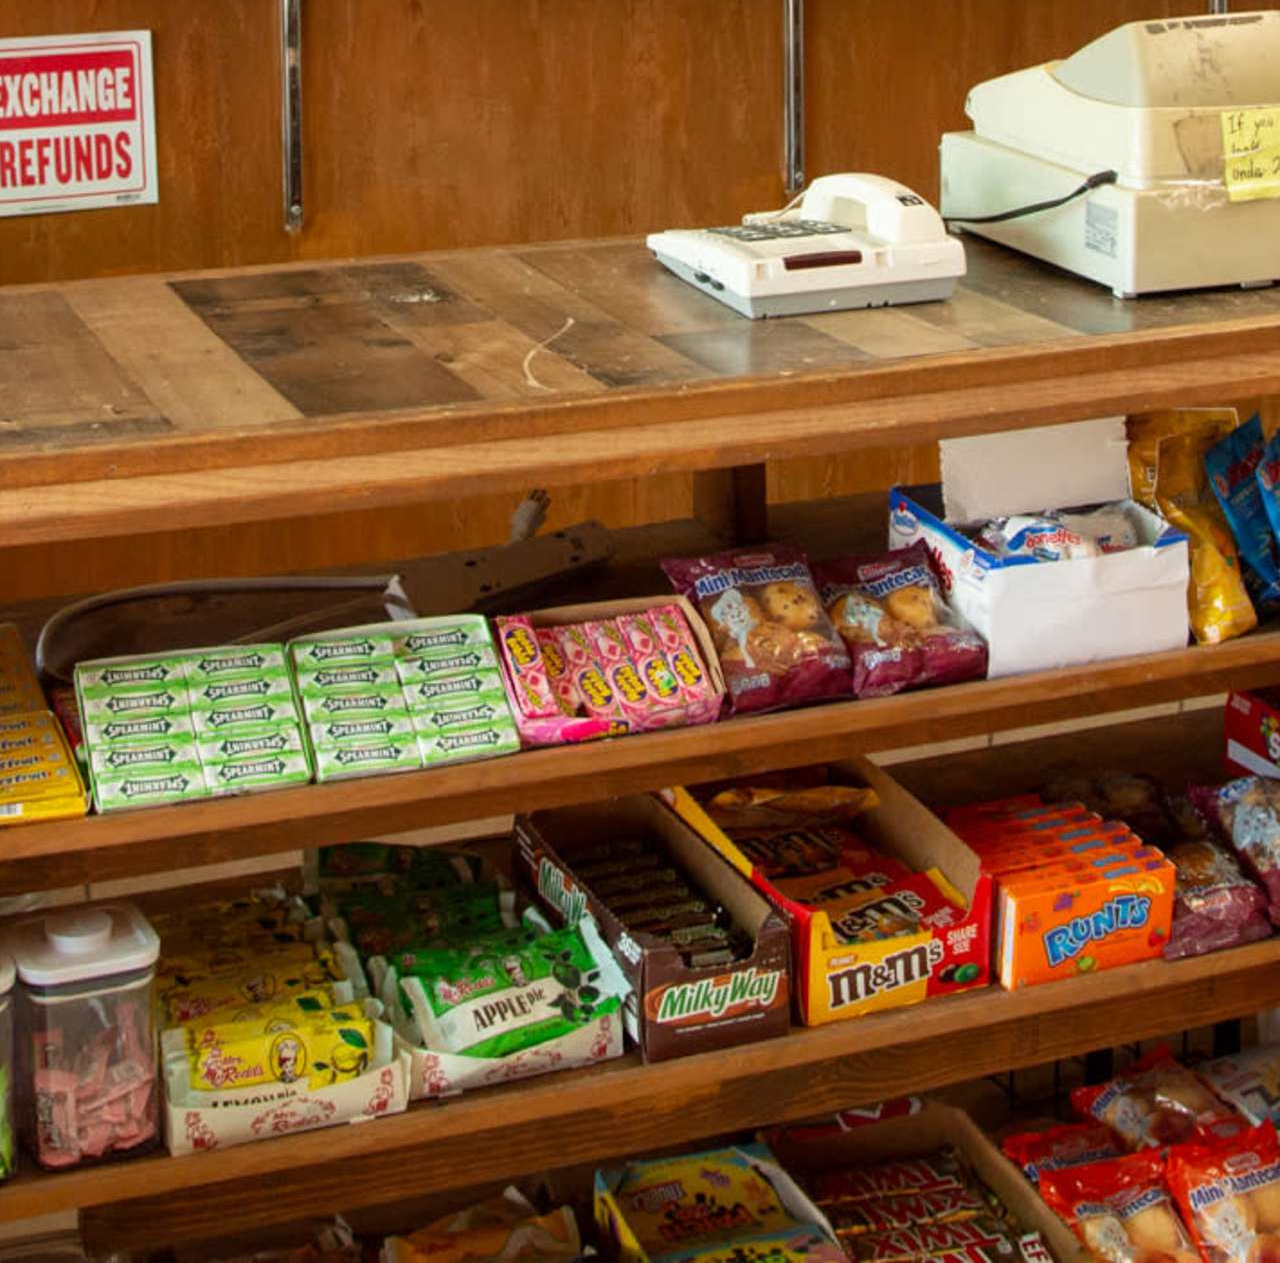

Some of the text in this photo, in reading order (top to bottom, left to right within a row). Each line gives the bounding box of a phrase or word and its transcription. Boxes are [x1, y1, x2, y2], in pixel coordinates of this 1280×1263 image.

[409, 632, 465, 649] SPEARMINT
[314, 643, 372, 658] SPEARMINT
[203, 655, 263, 672] SPEARMINT
[423, 657, 478, 673] SPEARMINT
[105, 667, 166, 683] SPEARMINT
[319, 670, 376, 686] SPEARMINT
[209, 681, 268, 698] SPEARMINT
[423, 681, 480, 697] SPEARMINT
[111, 695, 172, 710] SPEARMINT
[326, 696, 384, 712] SPEARMINT
[212, 707, 271, 725] SPEARMINT
[437, 708, 492, 725] SPEARMINT
[107, 720, 168, 737] SPEARMINT
[331, 722, 389, 738] SPEARMINT
[225, 735, 285, 753] SPEARMINT
[441, 732, 497, 750] SPEARMINT
[111, 748, 171, 765] SPEARMINT
[339, 748, 396, 764] SPEARMINT
[223, 761, 282, 779] SPEARMINT
[126, 777, 186, 795] SPEARMINT
[946, 924, 978, 941] SHARE
[1043, 894, 1152, 968] RUNTS
[472, 998, 533, 1034] APPLE
